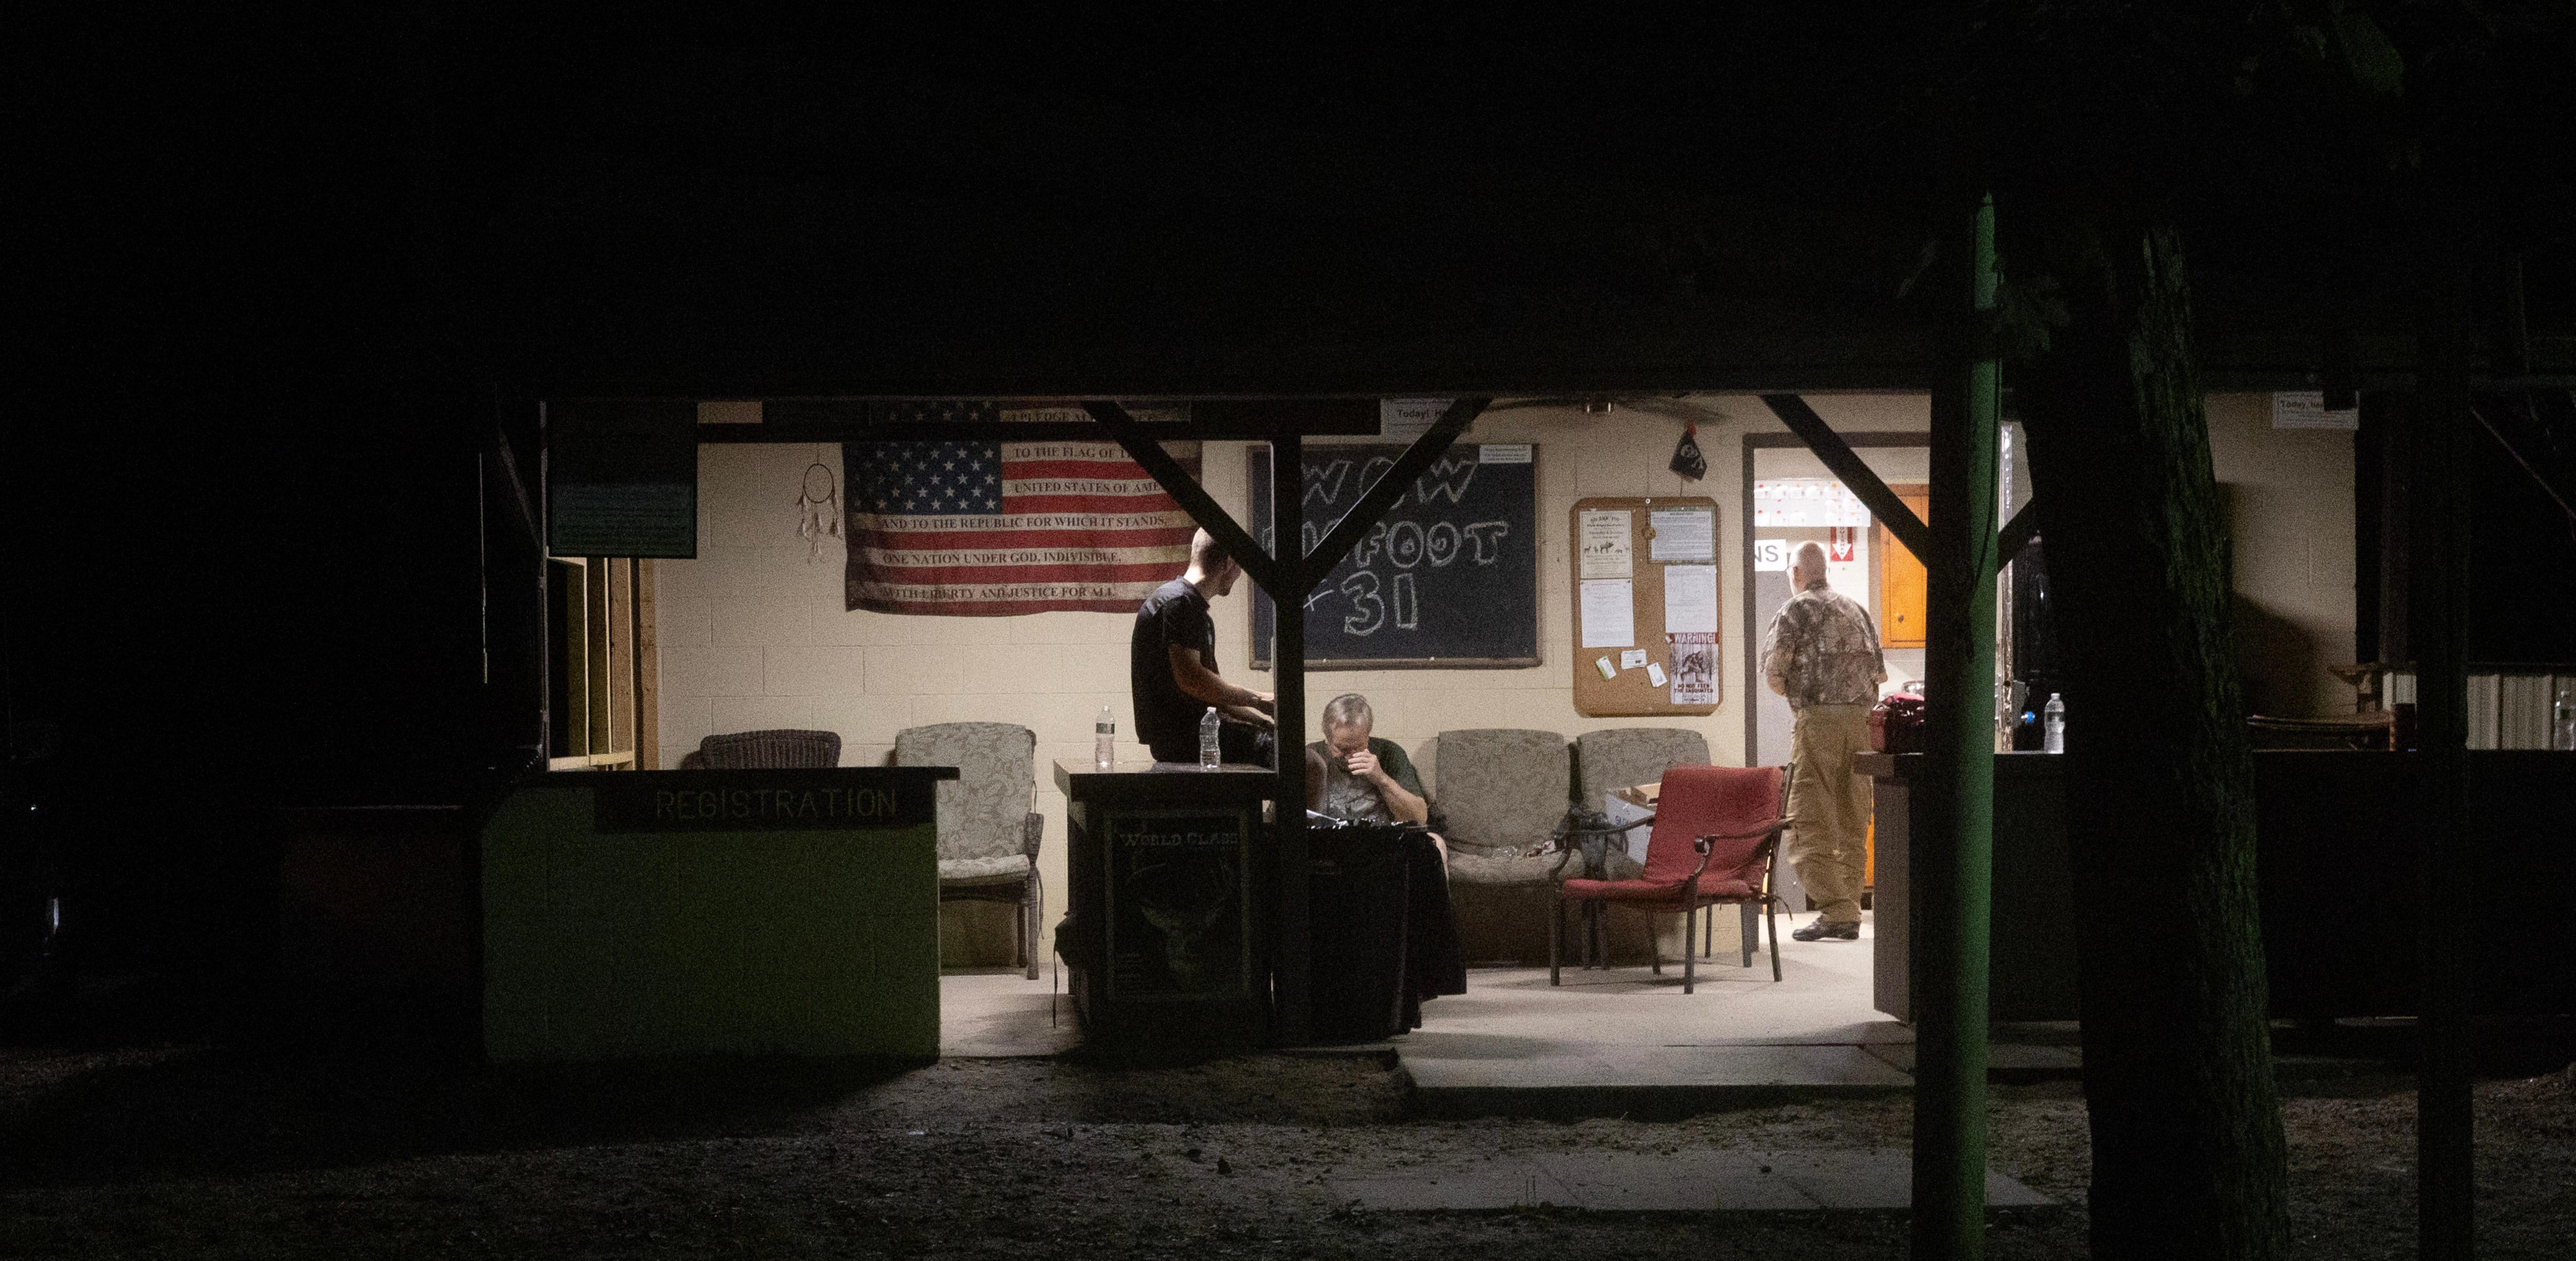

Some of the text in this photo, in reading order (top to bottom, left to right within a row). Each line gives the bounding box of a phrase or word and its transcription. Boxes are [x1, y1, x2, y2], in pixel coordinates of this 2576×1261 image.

[1015, 448, 1030, 458] TO
[1035, 447, 1059, 458] THE
[1063, 447, 1095, 458] FLAG
[1099, 448, 1114, 459] OF
[1015, 483, 1061, 494] UNITED
[1064, 483, 1110, 493] STATES
[1114, 483, 1128, 493] OF
[881, 518, 907, 529] AND
[913, 519, 928, 529] TO
[933, 518, 957, 529] THE
[961, 517, 1023, 529] REPUBLIC
[1027, 517, 1051, 527] FOR
[1055, 517, 1097, 527] WHICH
[1102, 517, 1114, 526] IT
[882, 553, 909, 565] ONE
[913, 554, 960, 565] NATION
[964, 553, 1006, 564] UNDER
[883, 588, 918, 599] WITH
[922, 588, 975, 599] LIBERTY
[980, 588, 1008, 598] AND
[1009, 588, 1059, 598] JUSTICE
[1062, 587, 1087, 597] FOR
[1340, 570, 1419, 637] 31
[656, 788, 897, 819] REGISTRATION
